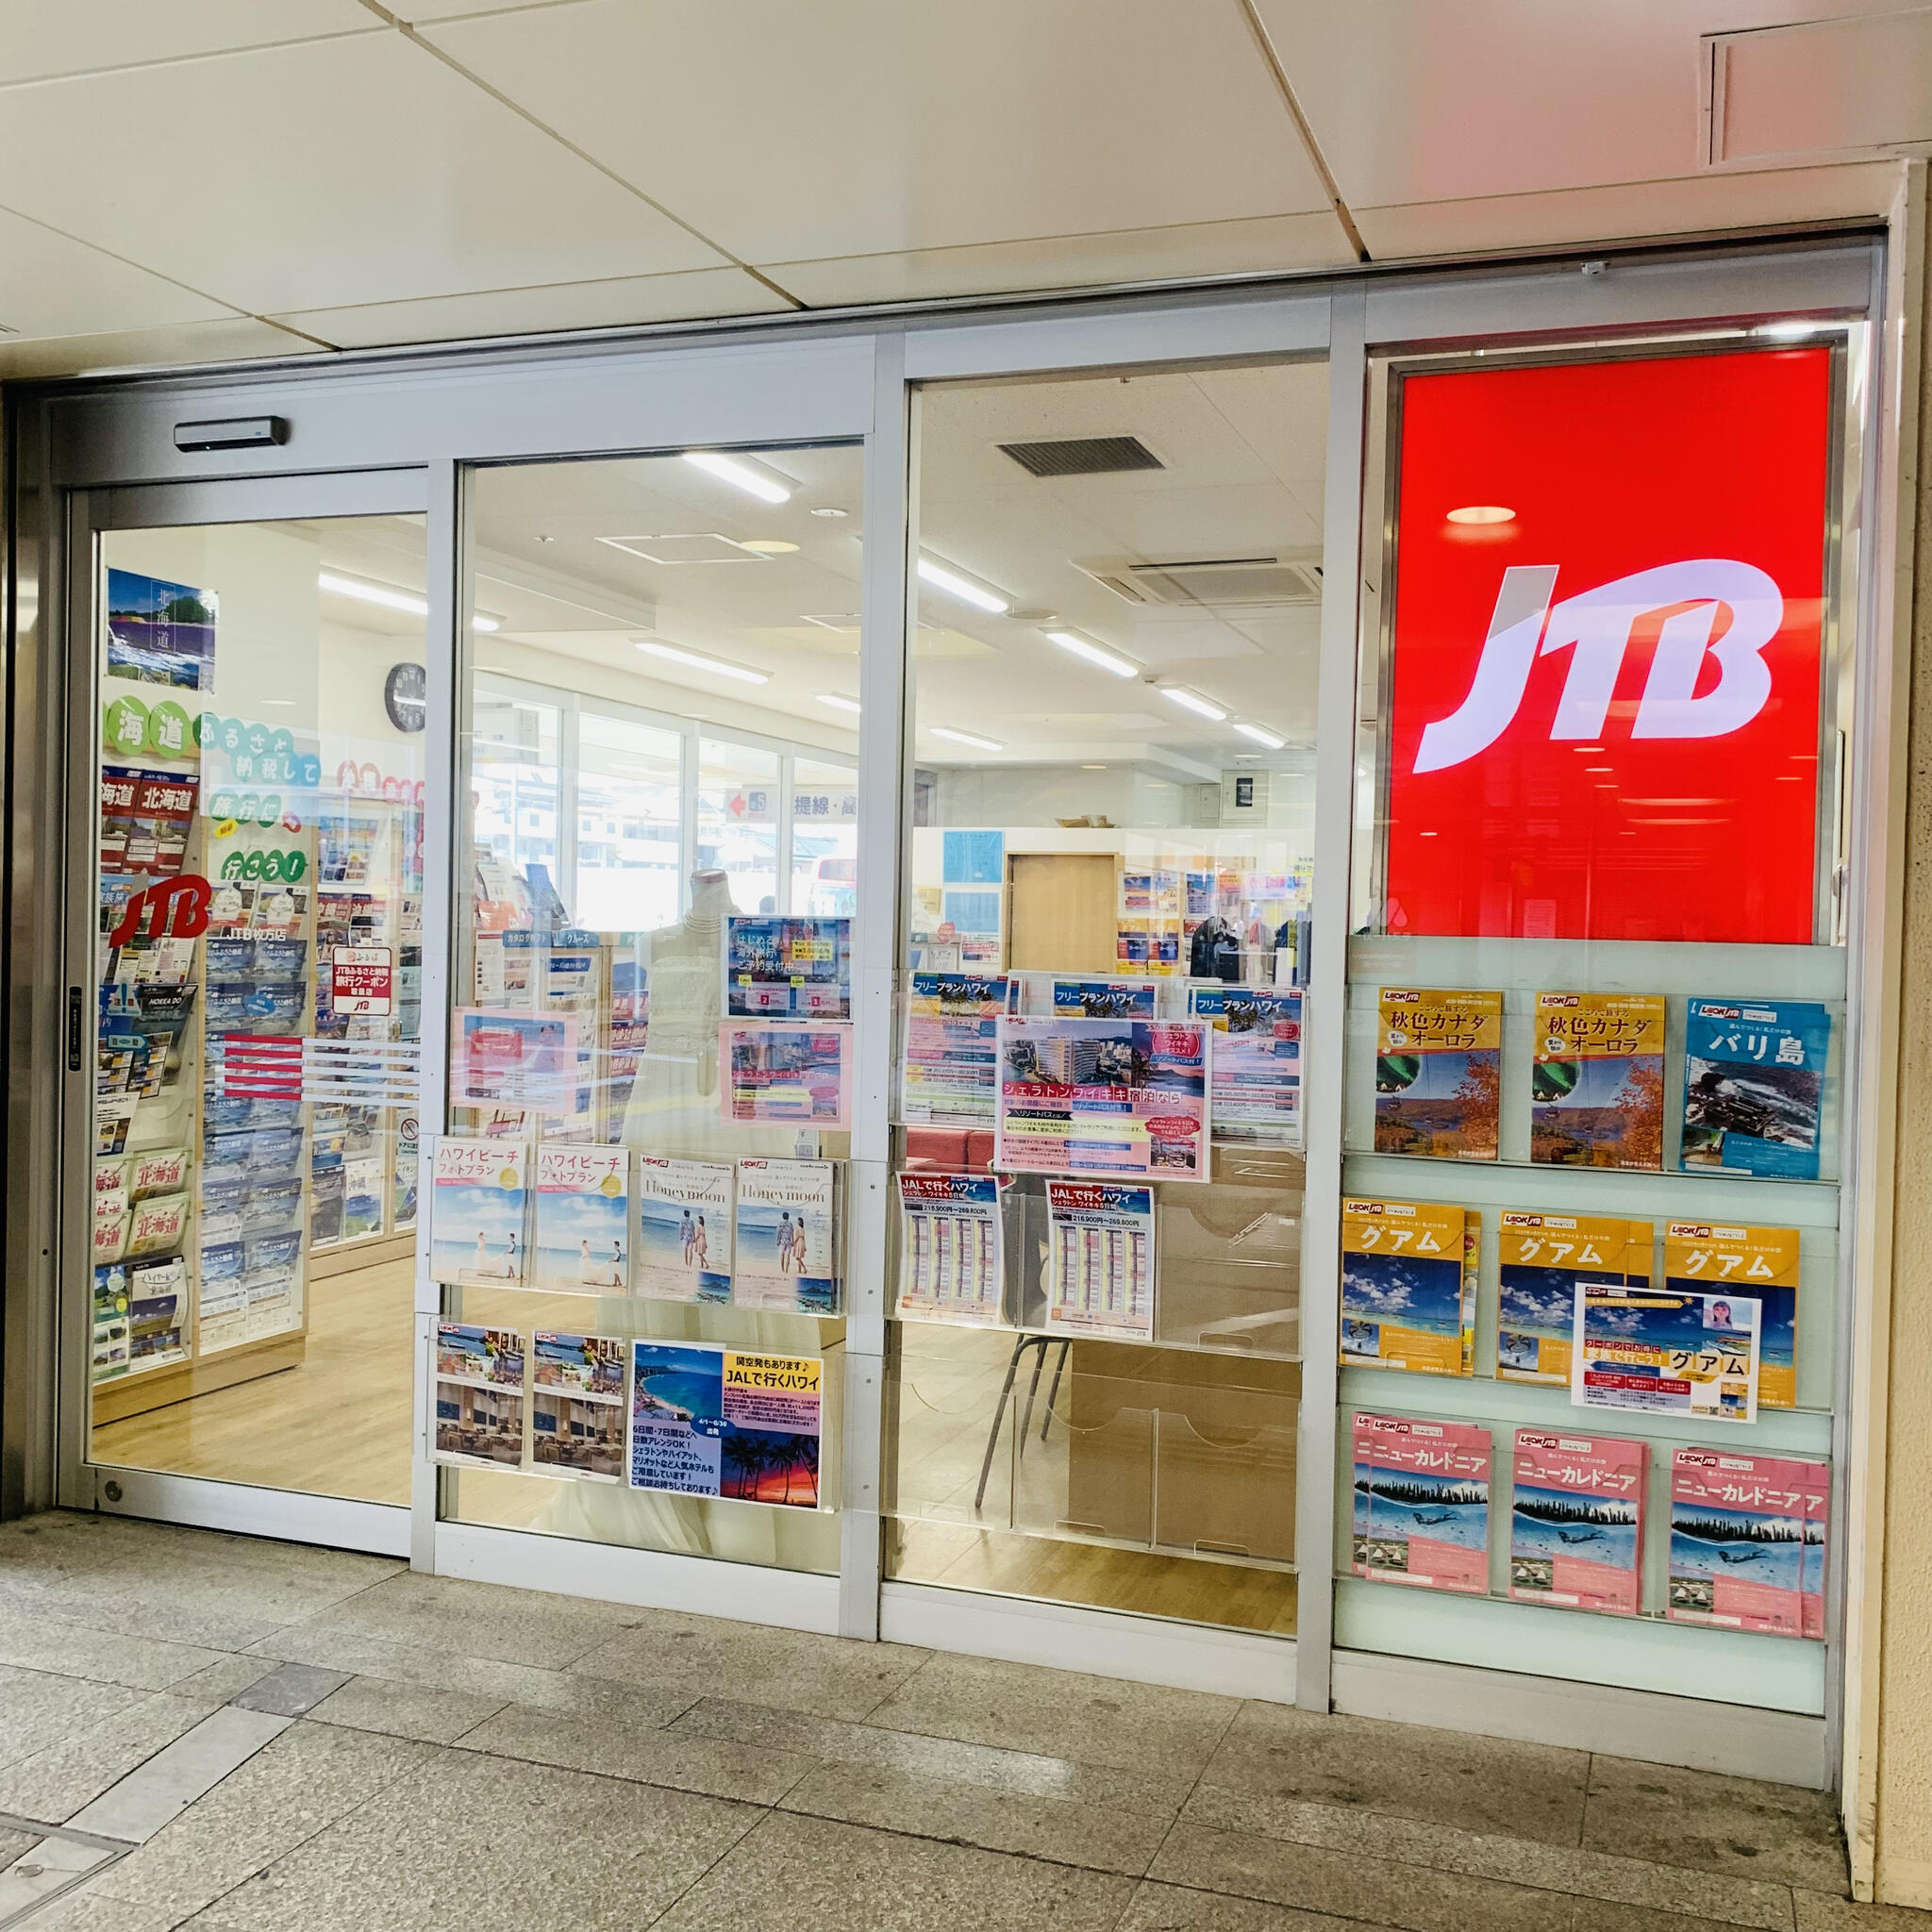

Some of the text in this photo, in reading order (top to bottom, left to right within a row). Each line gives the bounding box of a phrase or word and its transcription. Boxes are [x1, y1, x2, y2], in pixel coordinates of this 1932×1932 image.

[156, 588, 171, 649] 北海道
[1413, 558, 1783, 774] JTB
[199, 722, 288, 756] ふるさと
[236, 755, 318, 782] 納税して
[142, 787, 192, 811] 北海道
[212, 794, 277, 820] 旅行に
[108, 868, 211, 949] JTB
[335, 975, 389, 988] 旅行クーポン
[914, 981, 991, 994] フリープランハワイ
[354, 1000, 370, 1011] JTB
[1056, 991, 1137, 1006] フリープランハワイ
[1197, 998, 1283, 1013] フリープランハワイ
[1385, 991, 1407, 1002] LOOK
[1541, 996, 1565, 1006] LOOK
[1391, 1010, 1489, 1032] 秋色カナダ
[1701, 1007, 1725, 1017] LOOK
[1548, 1016, 1653, 1036] 秋色カナダ
[1411, 1030, 1476, 1049] オーロラ
[1571, 1037, 1639, 1055] オーロラ
[1708, 1033, 1806, 1066] バリ島
[440, 1148, 519, 1164] ハワイビーチ
[541, 1155, 621, 1171] ハワイビーチ
[138, 1163, 180, 1187] 北海道
[439, 1163, 495, 1176] フォトプラン
[541, 1170, 596, 1183] フォトプラン
[645, 1179, 725, 1203] Honeymoon
[742, 1184, 825, 1203] Honeymoon
[902, 1179, 978, 1193] JALで行くハワイ
[1051, 1189, 1132, 1204] JALで行くハワイ
[1348, 1203, 1370, 1213] LOOK
[137, 1214, 180, 1239] 北海道
[1506, 1215, 1528, 1224] LOOK
[1361, 1224, 1441, 1253] グアム
[1672, 1225, 1696, 1236] LOOK
[1519, 1237, 1603, 1265] グアム
[1685, 1249, 1774, 1278] グアム
[1585, 1340, 1661, 1355] クーポンでお得に
[1586, 1348, 1663, 1366] 家族で行こう！
[1672, 1351, 1745, 1376] グアム
[725, 1369, 820, 1391] JALで行くハワイ
[707, 1427, 720, 1436] 出発
[1374, 1421, 1397, 1431] LOOK
[1520, 1436, 1543, 1446] LOOK
[632, 1457, 715, 1474] マリオットなど人気ホテルも
[1374, 1444, 1487, 1473] ニューカレドニア
[1678, 1454, 1703, 1464] LOOK
[1517, 1461, 1637, 1492] ニューカレドニア
[1675, 1478, 1801, 1508] ニューカレドニア
